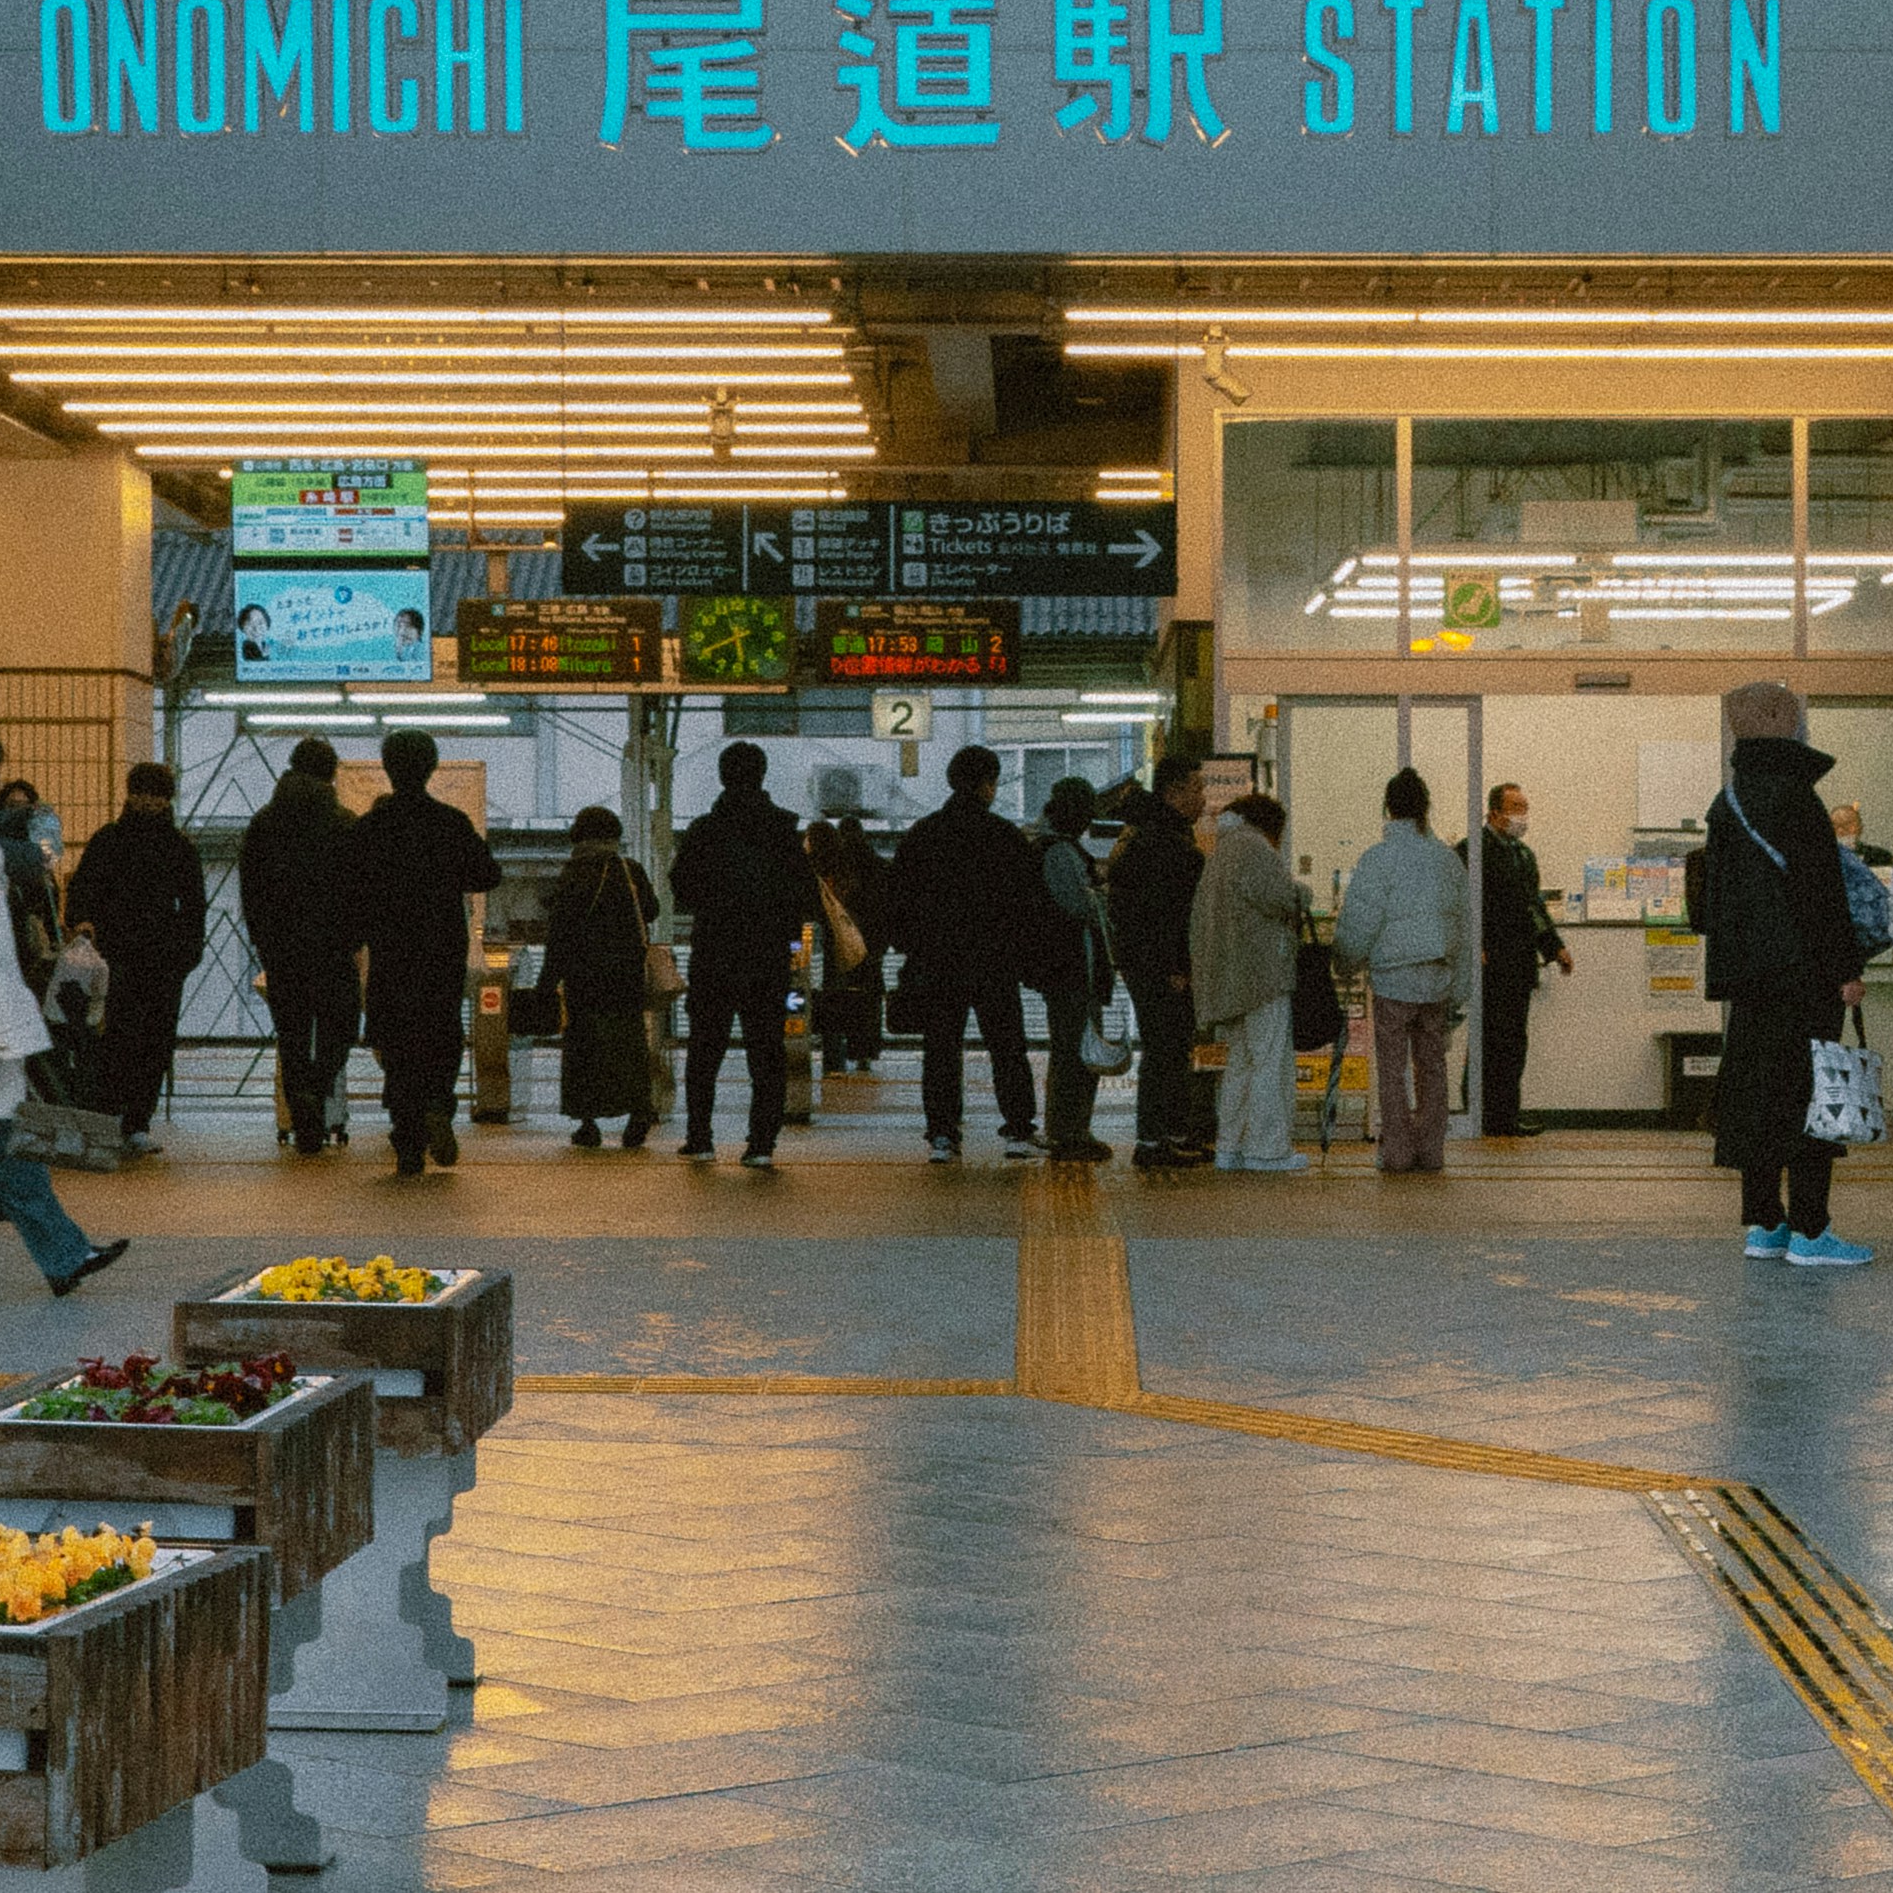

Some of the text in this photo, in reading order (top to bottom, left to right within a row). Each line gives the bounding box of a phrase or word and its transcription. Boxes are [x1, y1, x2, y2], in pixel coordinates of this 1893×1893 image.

[928, 511, 1072, 534] きっぷうりば
[929, 537, 993, 554] Tickets
[650, 565, 738, 577] コインロッカー
[818, 565, 883, 577] レストラン
[932, 563, 1012, 575] エレベーター
[470, 634, 508, 652] Local
[632, 634, 642, 652] 1
[867, 635, 919, 653] 17:53
[989, 635, 1003, 653] 2
[470, 656, 508, 672] Local
[509, 656, 559, 673] 18:08
[632, 656, 642, 673] 1
[890, 701, 914, 735] 2
